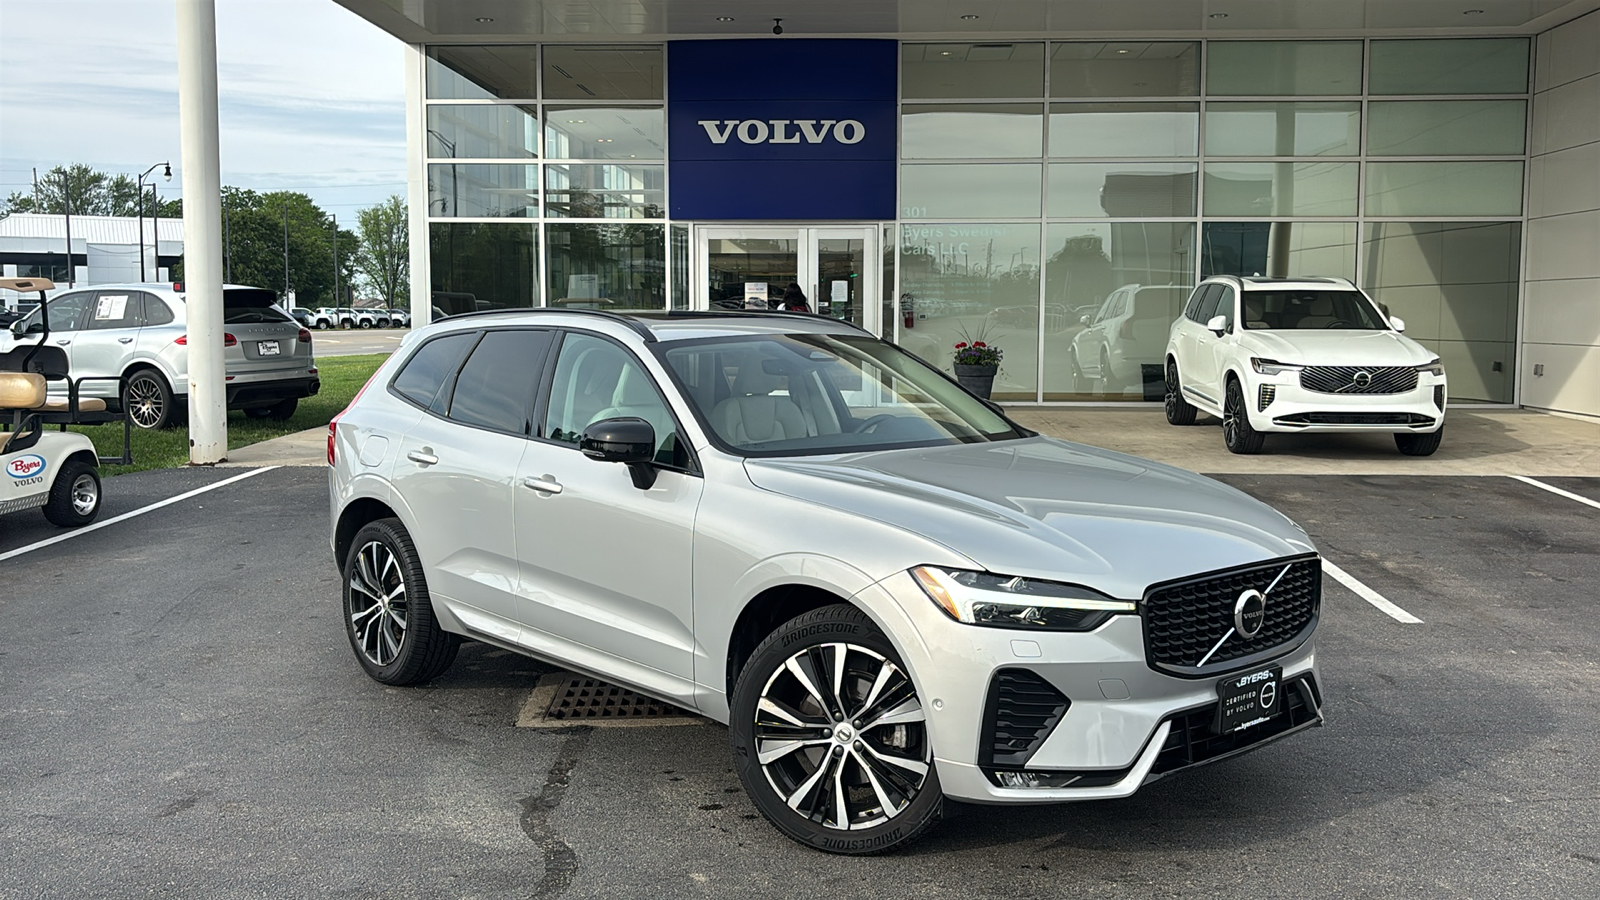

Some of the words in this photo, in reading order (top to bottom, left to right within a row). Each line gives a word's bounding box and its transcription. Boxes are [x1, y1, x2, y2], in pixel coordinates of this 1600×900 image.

[698, 119, 866, 144] VOLVO
[902, 206, 927, 218] 301
[902, 225, 943, 240] Byers
[901, 242, 935, 255] Cars
[940, 242, 969, 255] LLC
[14, 476, 43, 487] VOLVO
[781, 623, 860, 648] BRIDGESTONE
[1240, 670, 1270, 687] BYERS
[1226, 691, 1256, 706] CERTIFIED
[1226, 708, 1234, 717] BY
[1235, 702, 1254, 713] VOLVO
[823, 828, 904, 851] BRIDGESTONE
